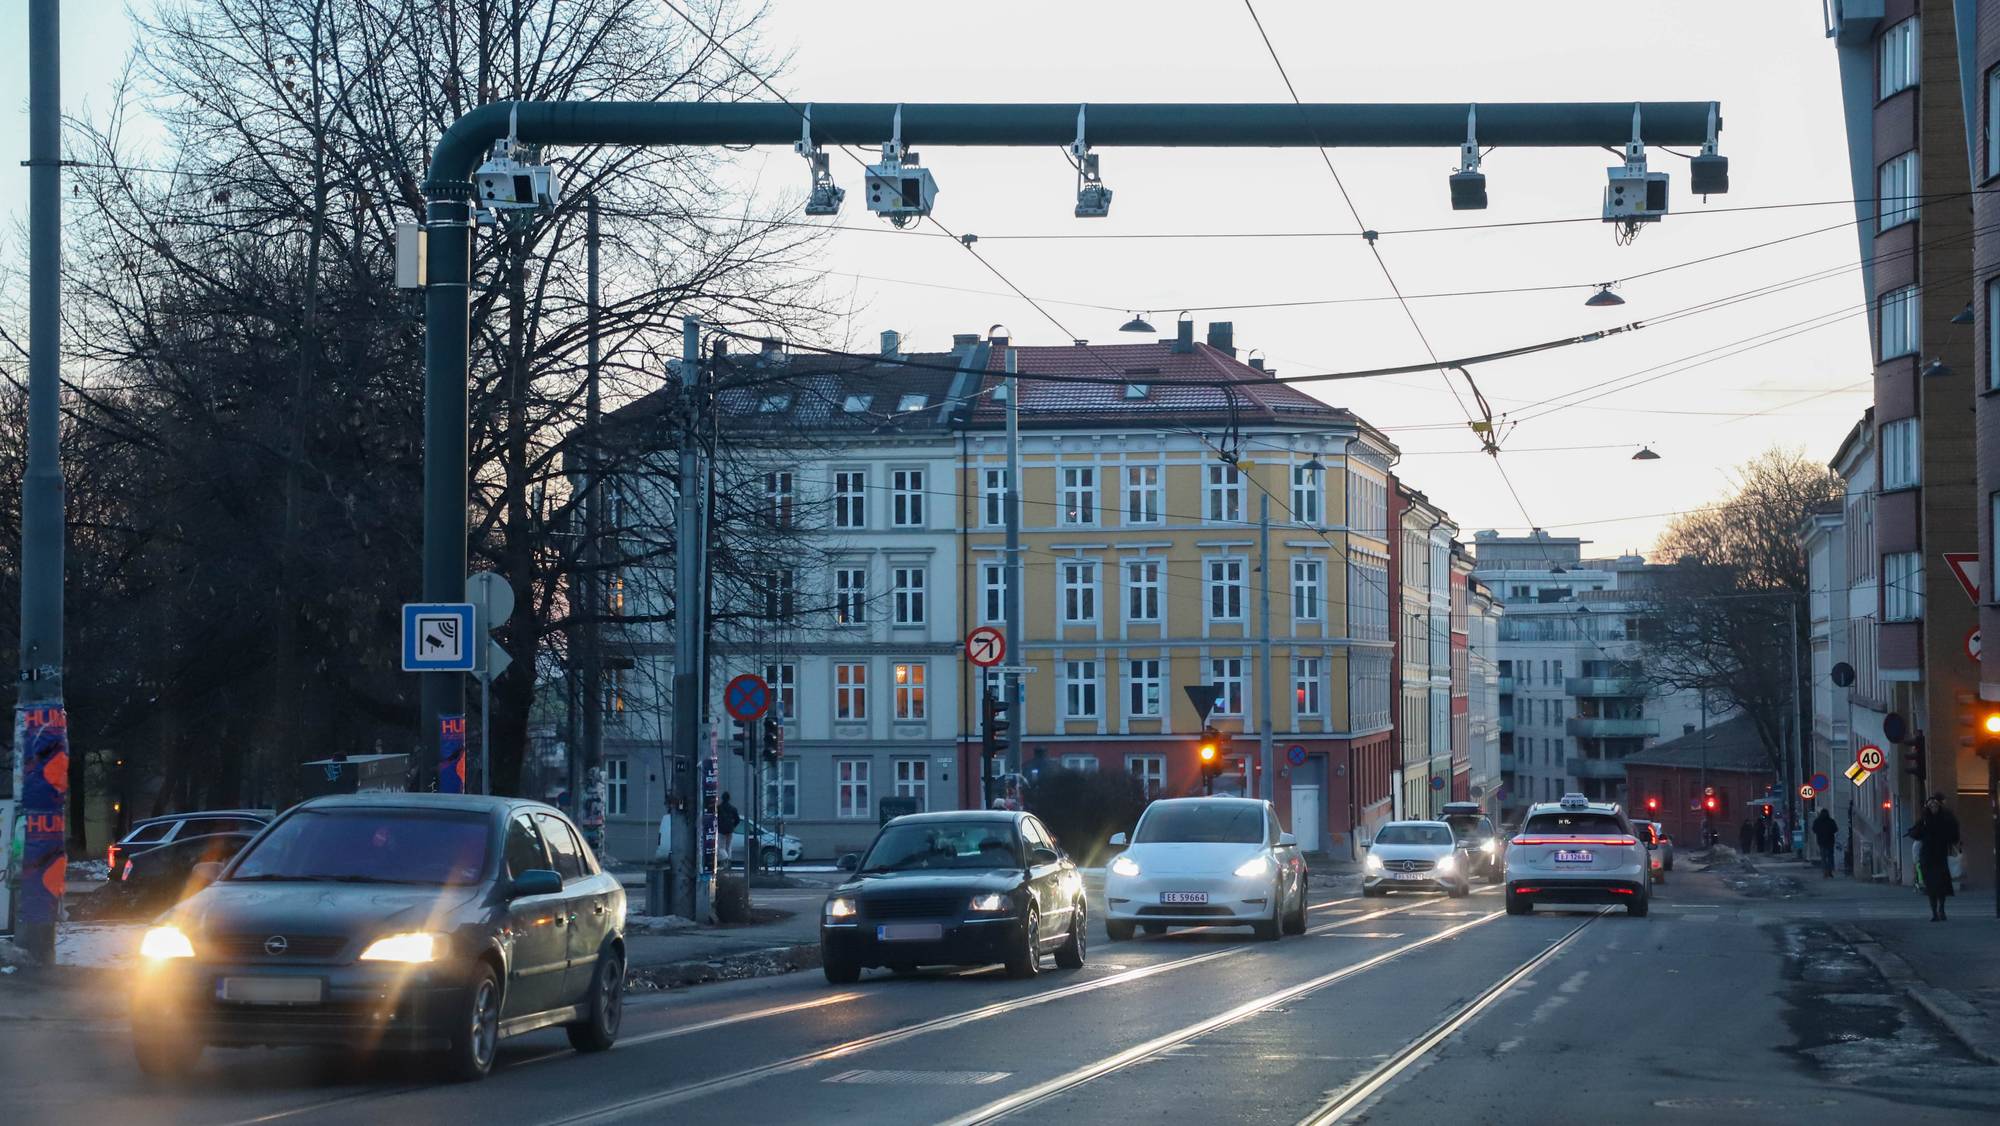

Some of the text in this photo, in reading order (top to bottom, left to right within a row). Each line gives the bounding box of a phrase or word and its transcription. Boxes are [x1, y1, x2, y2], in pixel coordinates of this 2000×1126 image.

[1862, 752, 1880, 765] 40
[1802, 788, 1812, 796] 40
[1167, 893, 1205, 902] EE 59664
